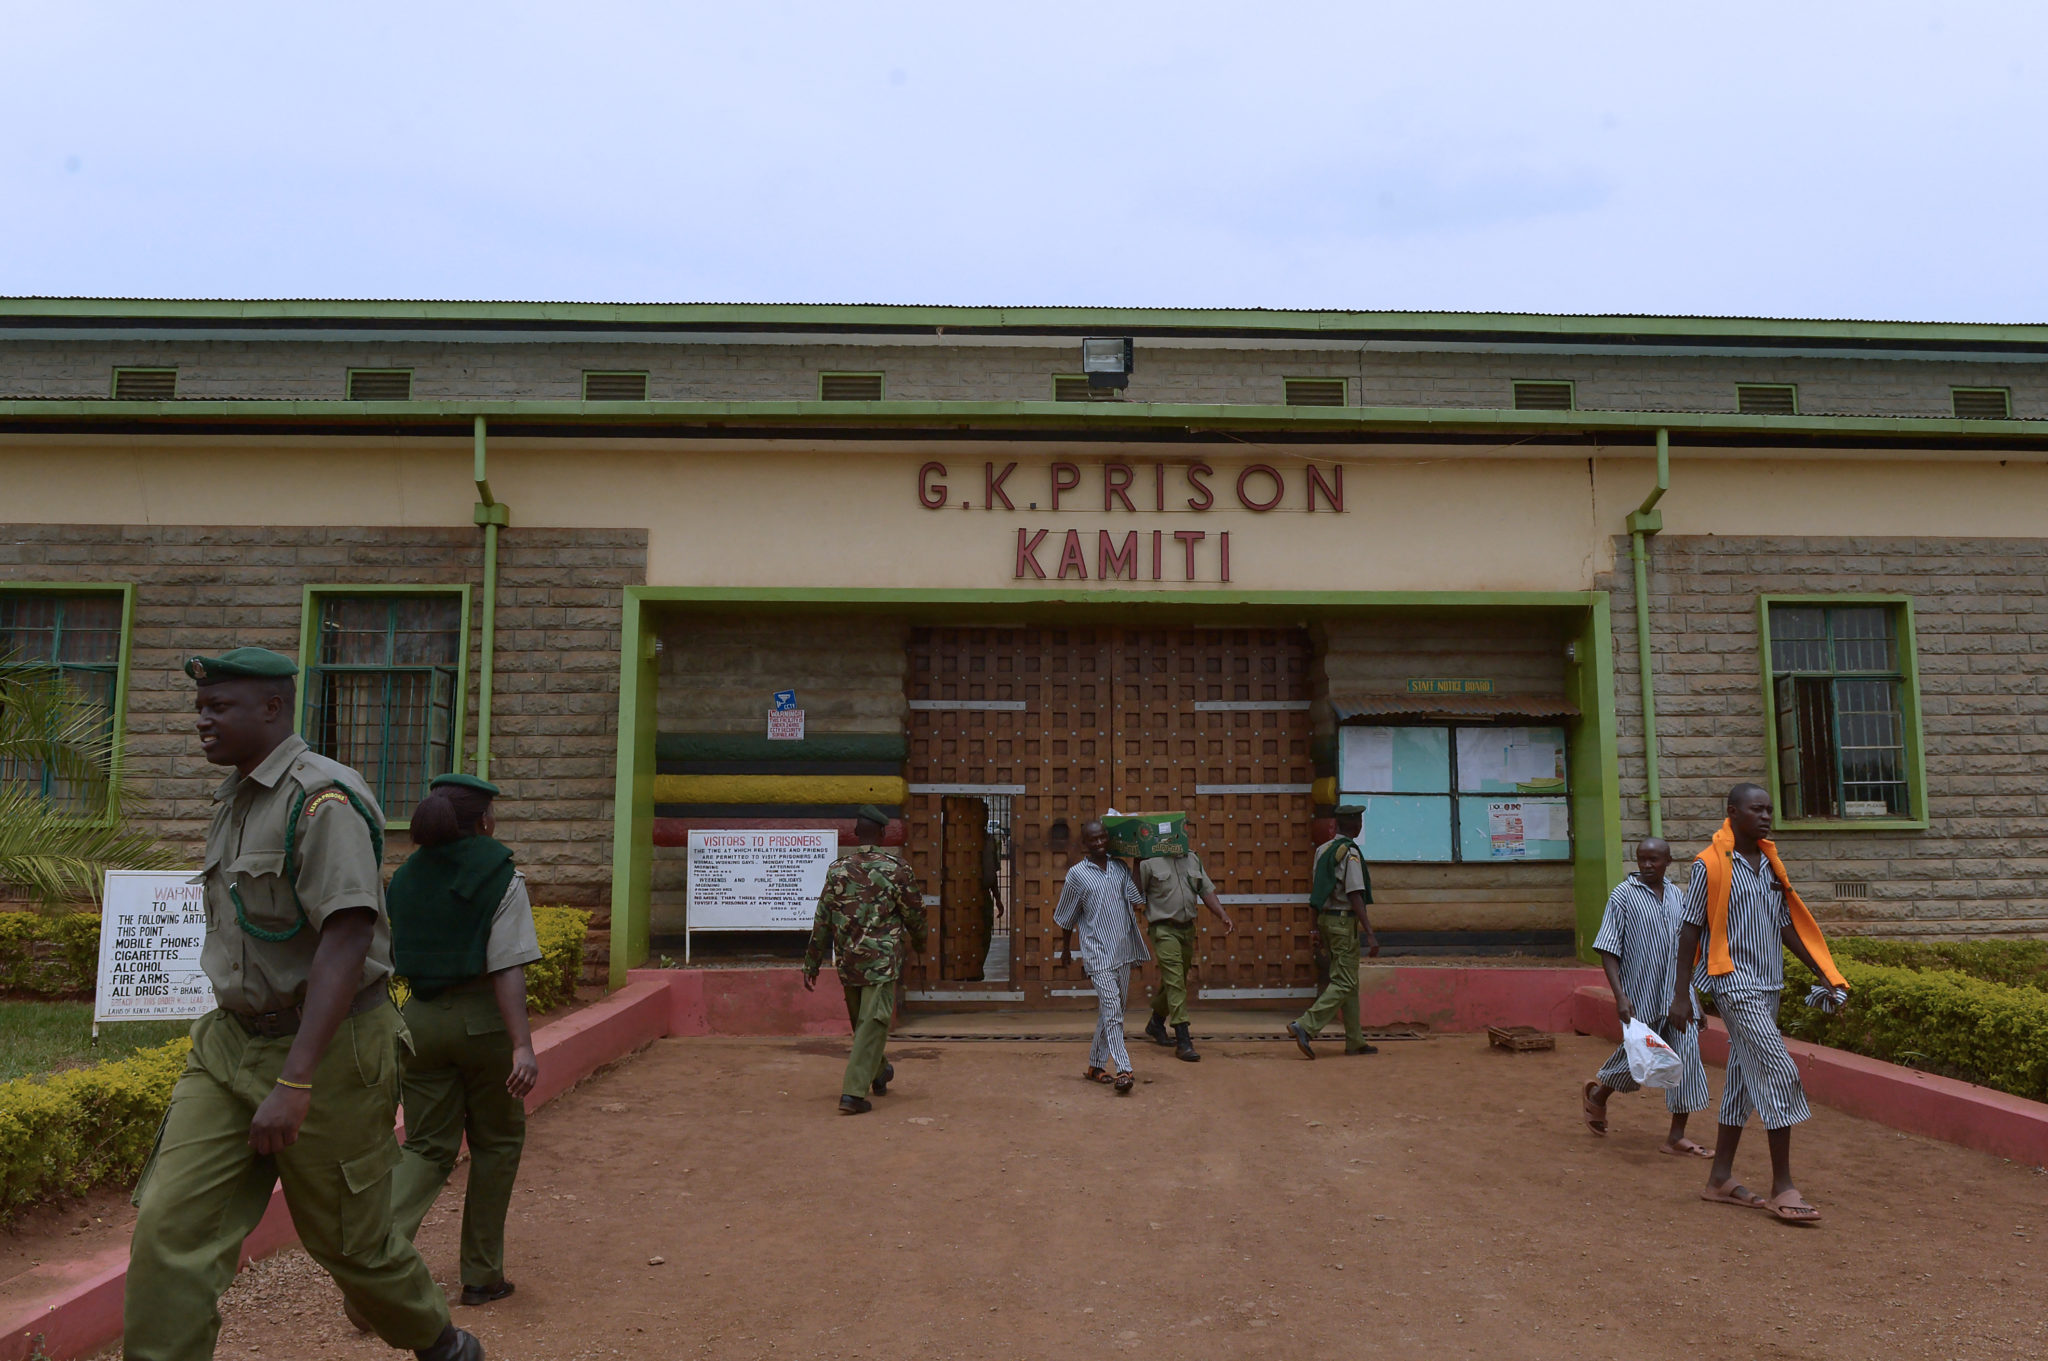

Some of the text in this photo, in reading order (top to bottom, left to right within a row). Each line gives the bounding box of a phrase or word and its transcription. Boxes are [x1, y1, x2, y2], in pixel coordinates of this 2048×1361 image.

[1015, 527, 1230, 582] KAMITI
[1411, 681, 1490, 692] STAFF NOTICE BOARD
[309, 798, 321, 813] KENYA
[703, 836, 822, 847] VISITORS TO PRISONERS
[152, 901, 200, 912] TO ALL
[118, 914, 134, 925] THE
[138, 914, 180, 925] FOLLOWING
[117, 926, 136, 937] THIS
[115, 937, 200, 949] MOBILE PHONES
[114, 950, 179, 961] CIGARETTES
[114, 962, 163, 973] ALCOHOL
[112, 973, 170, 985] FIRE ARMS
[112, 986, 131, 997] ALL
[135, 985, 169, 996] DRUGS
